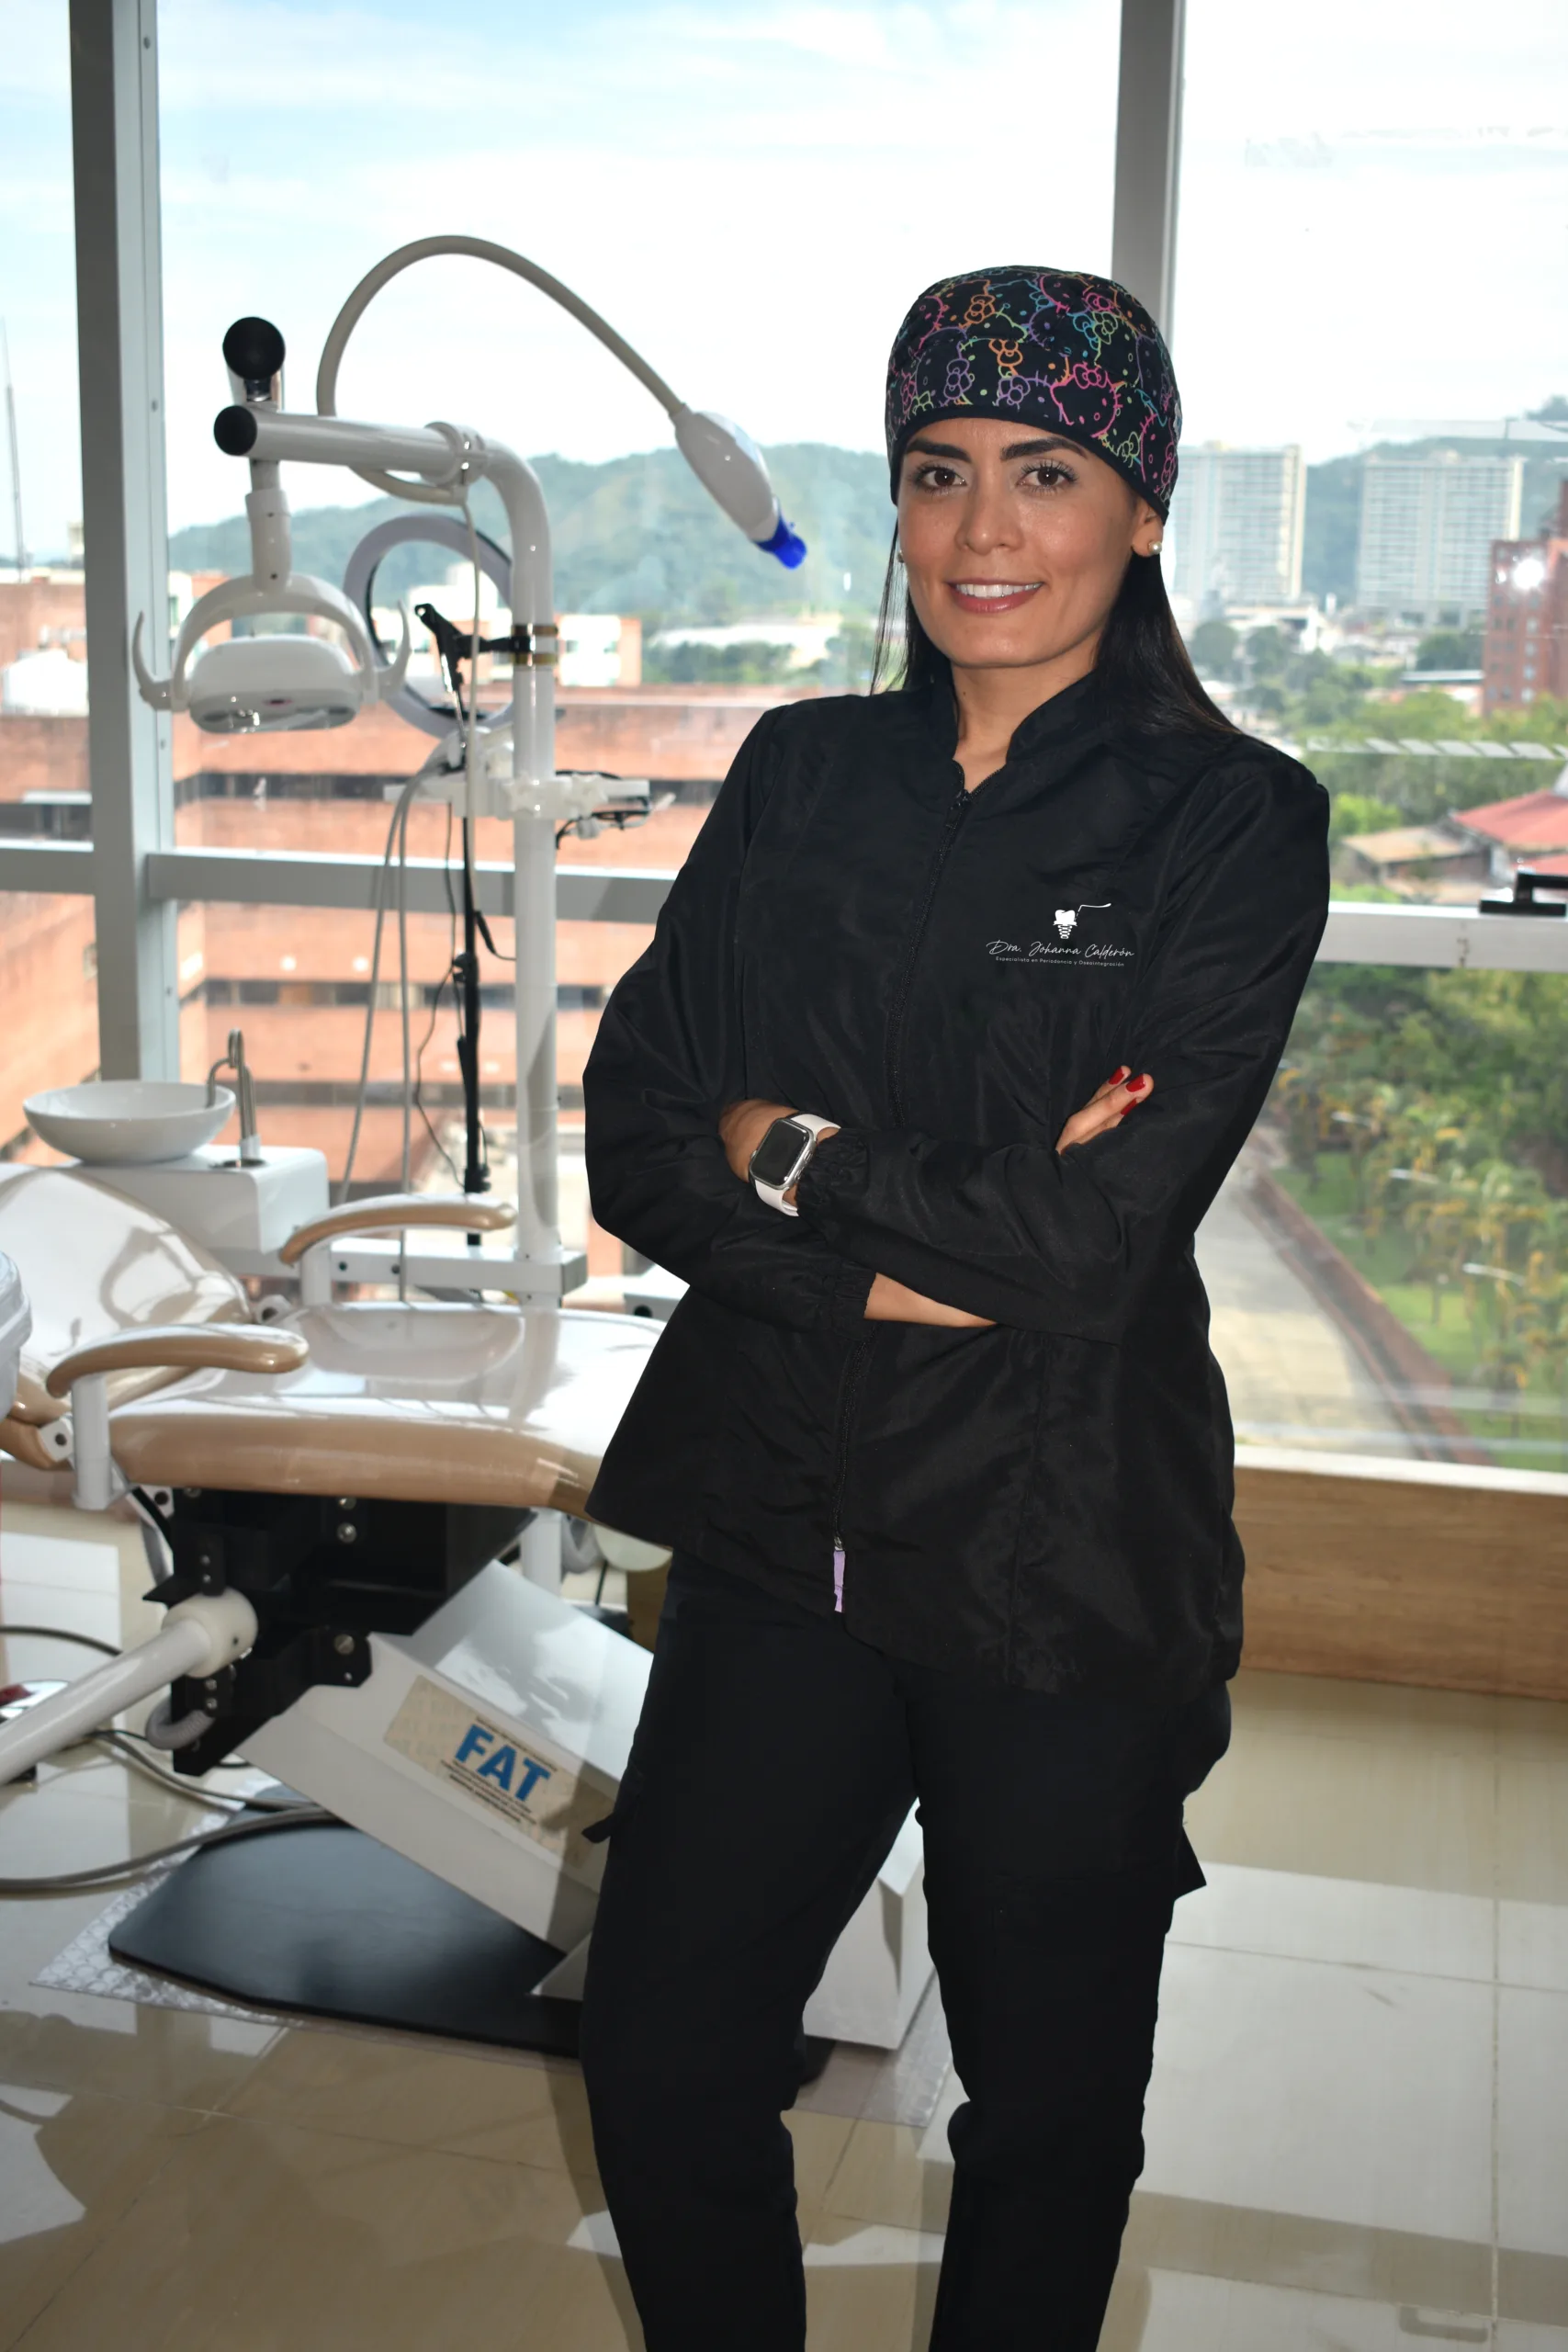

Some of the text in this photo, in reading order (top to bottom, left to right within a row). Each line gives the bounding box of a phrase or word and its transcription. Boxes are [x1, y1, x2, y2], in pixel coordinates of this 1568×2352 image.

[986, 939, 1134, 959] Dra. Johanna Calderón
[455, 1724, 552, 1802] FAT
